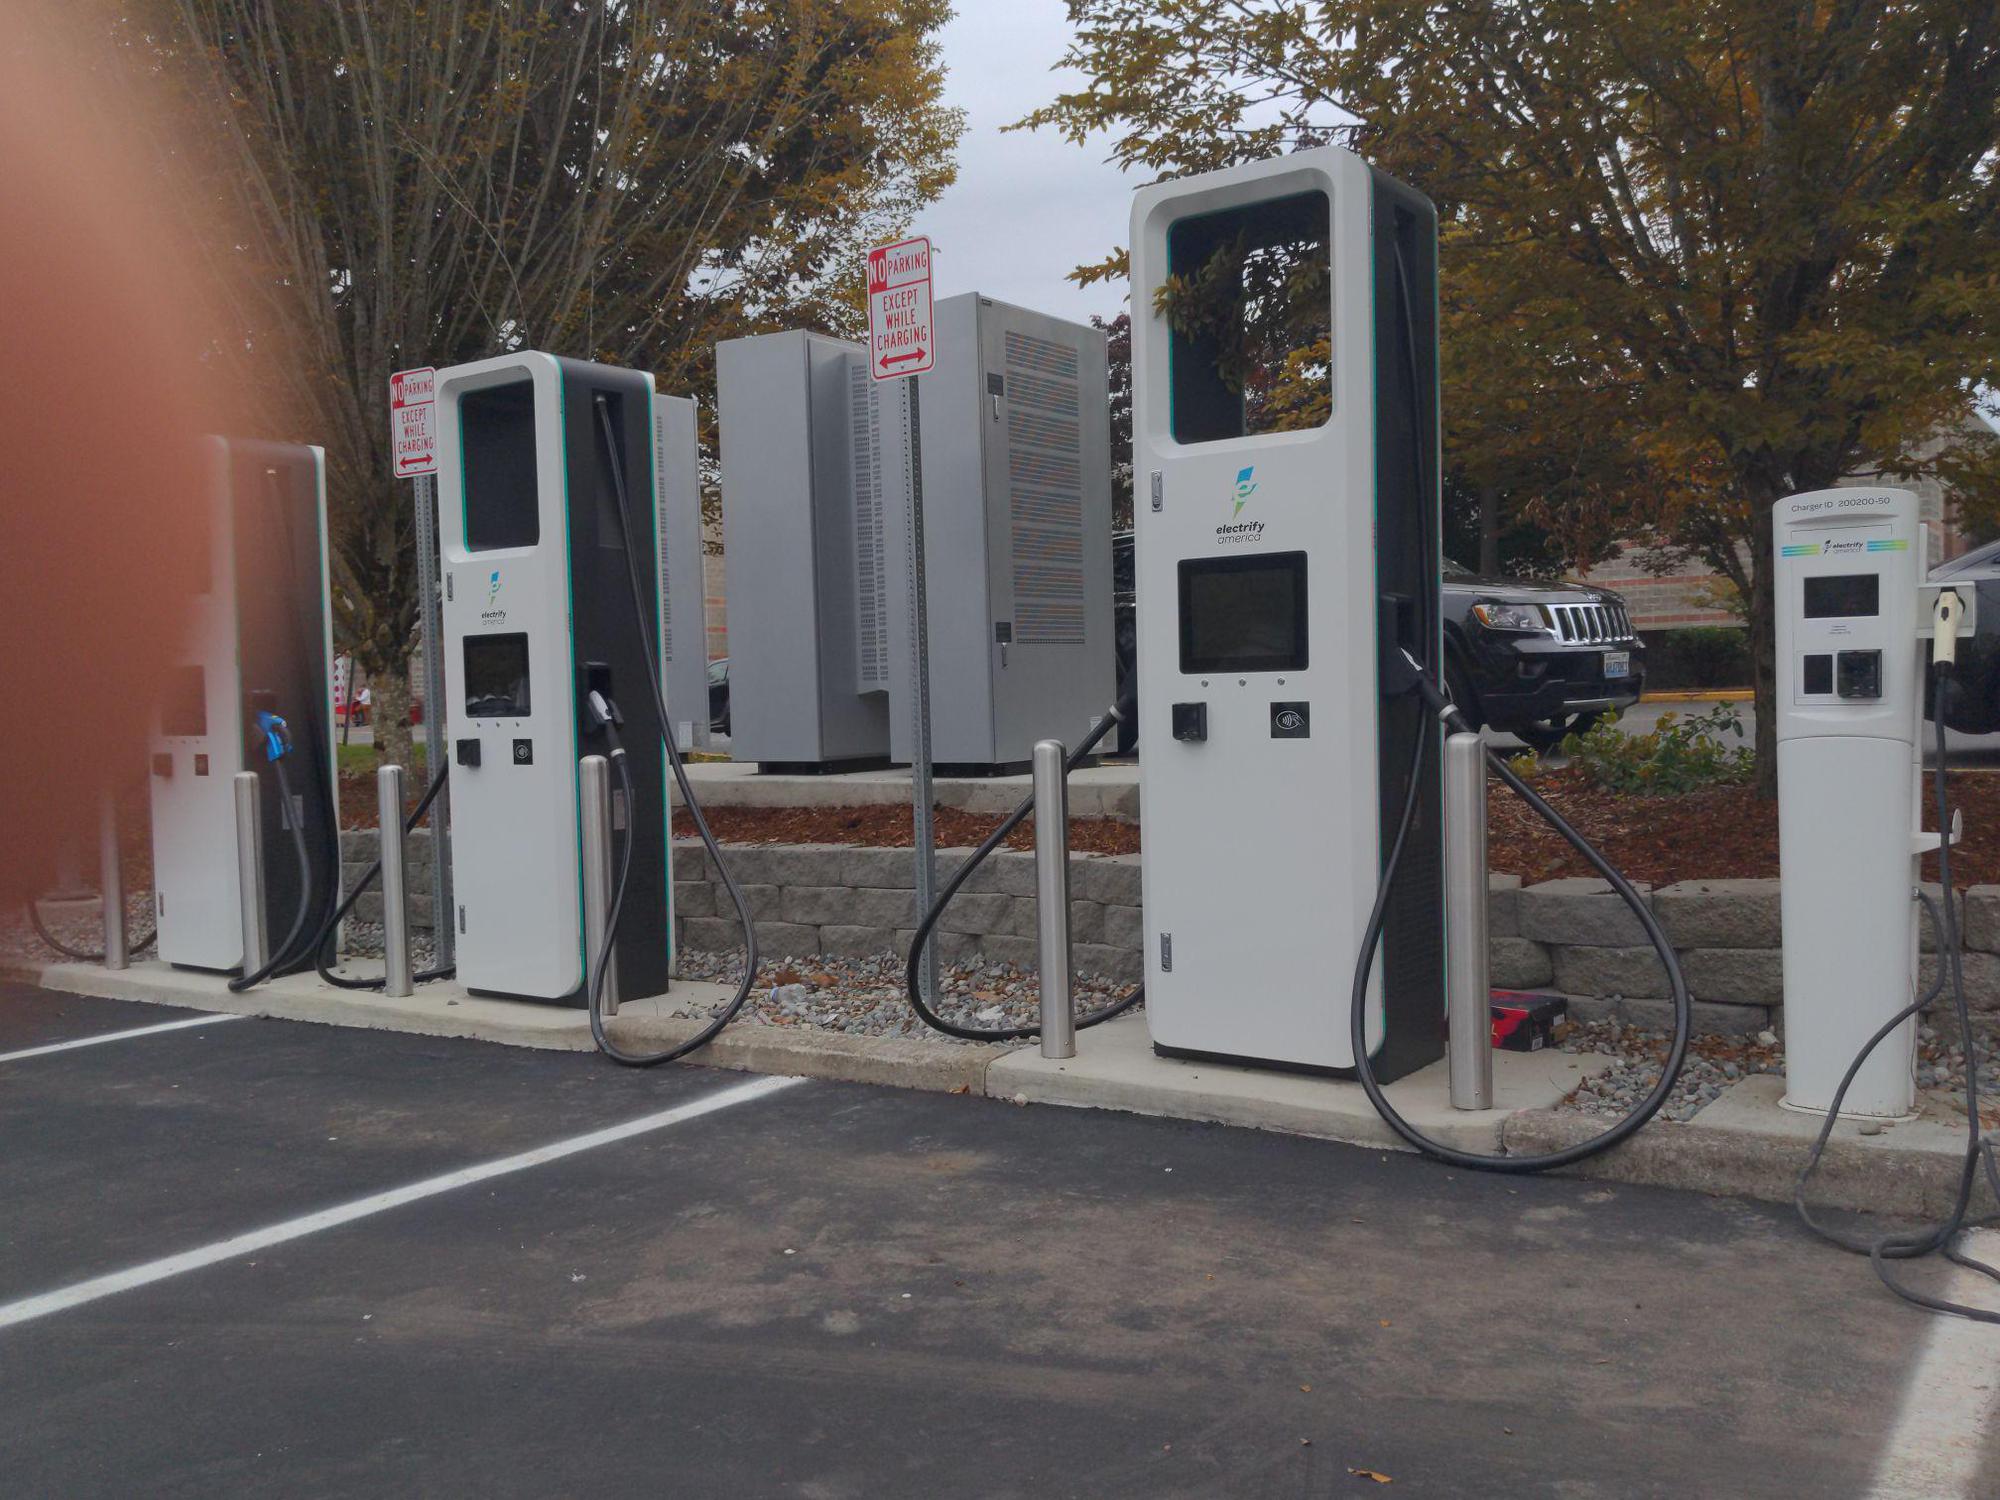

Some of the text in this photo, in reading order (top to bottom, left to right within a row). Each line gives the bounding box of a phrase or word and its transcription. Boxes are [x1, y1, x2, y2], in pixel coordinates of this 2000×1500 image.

[870, 252, 927, 284] NO PARKING
[884, 289, 918, 311] EXCEPT
[886, 309, 916, 329] WHILE
[878, 326, 927, 351] CHARGING
[393, 380, 433, 402] NO PARKING
[402, 408, 427, 424] EXCEPT
[404, 423, 425, 438] WHILE
[399, 437, 433, 454] CHARGING
[1791, 503, 1822, 512] Charger
[1216, 521, 1265, 534] electrify
[1217, 534, 1261, 544] america
[481, 610, 506, 619] electrify
